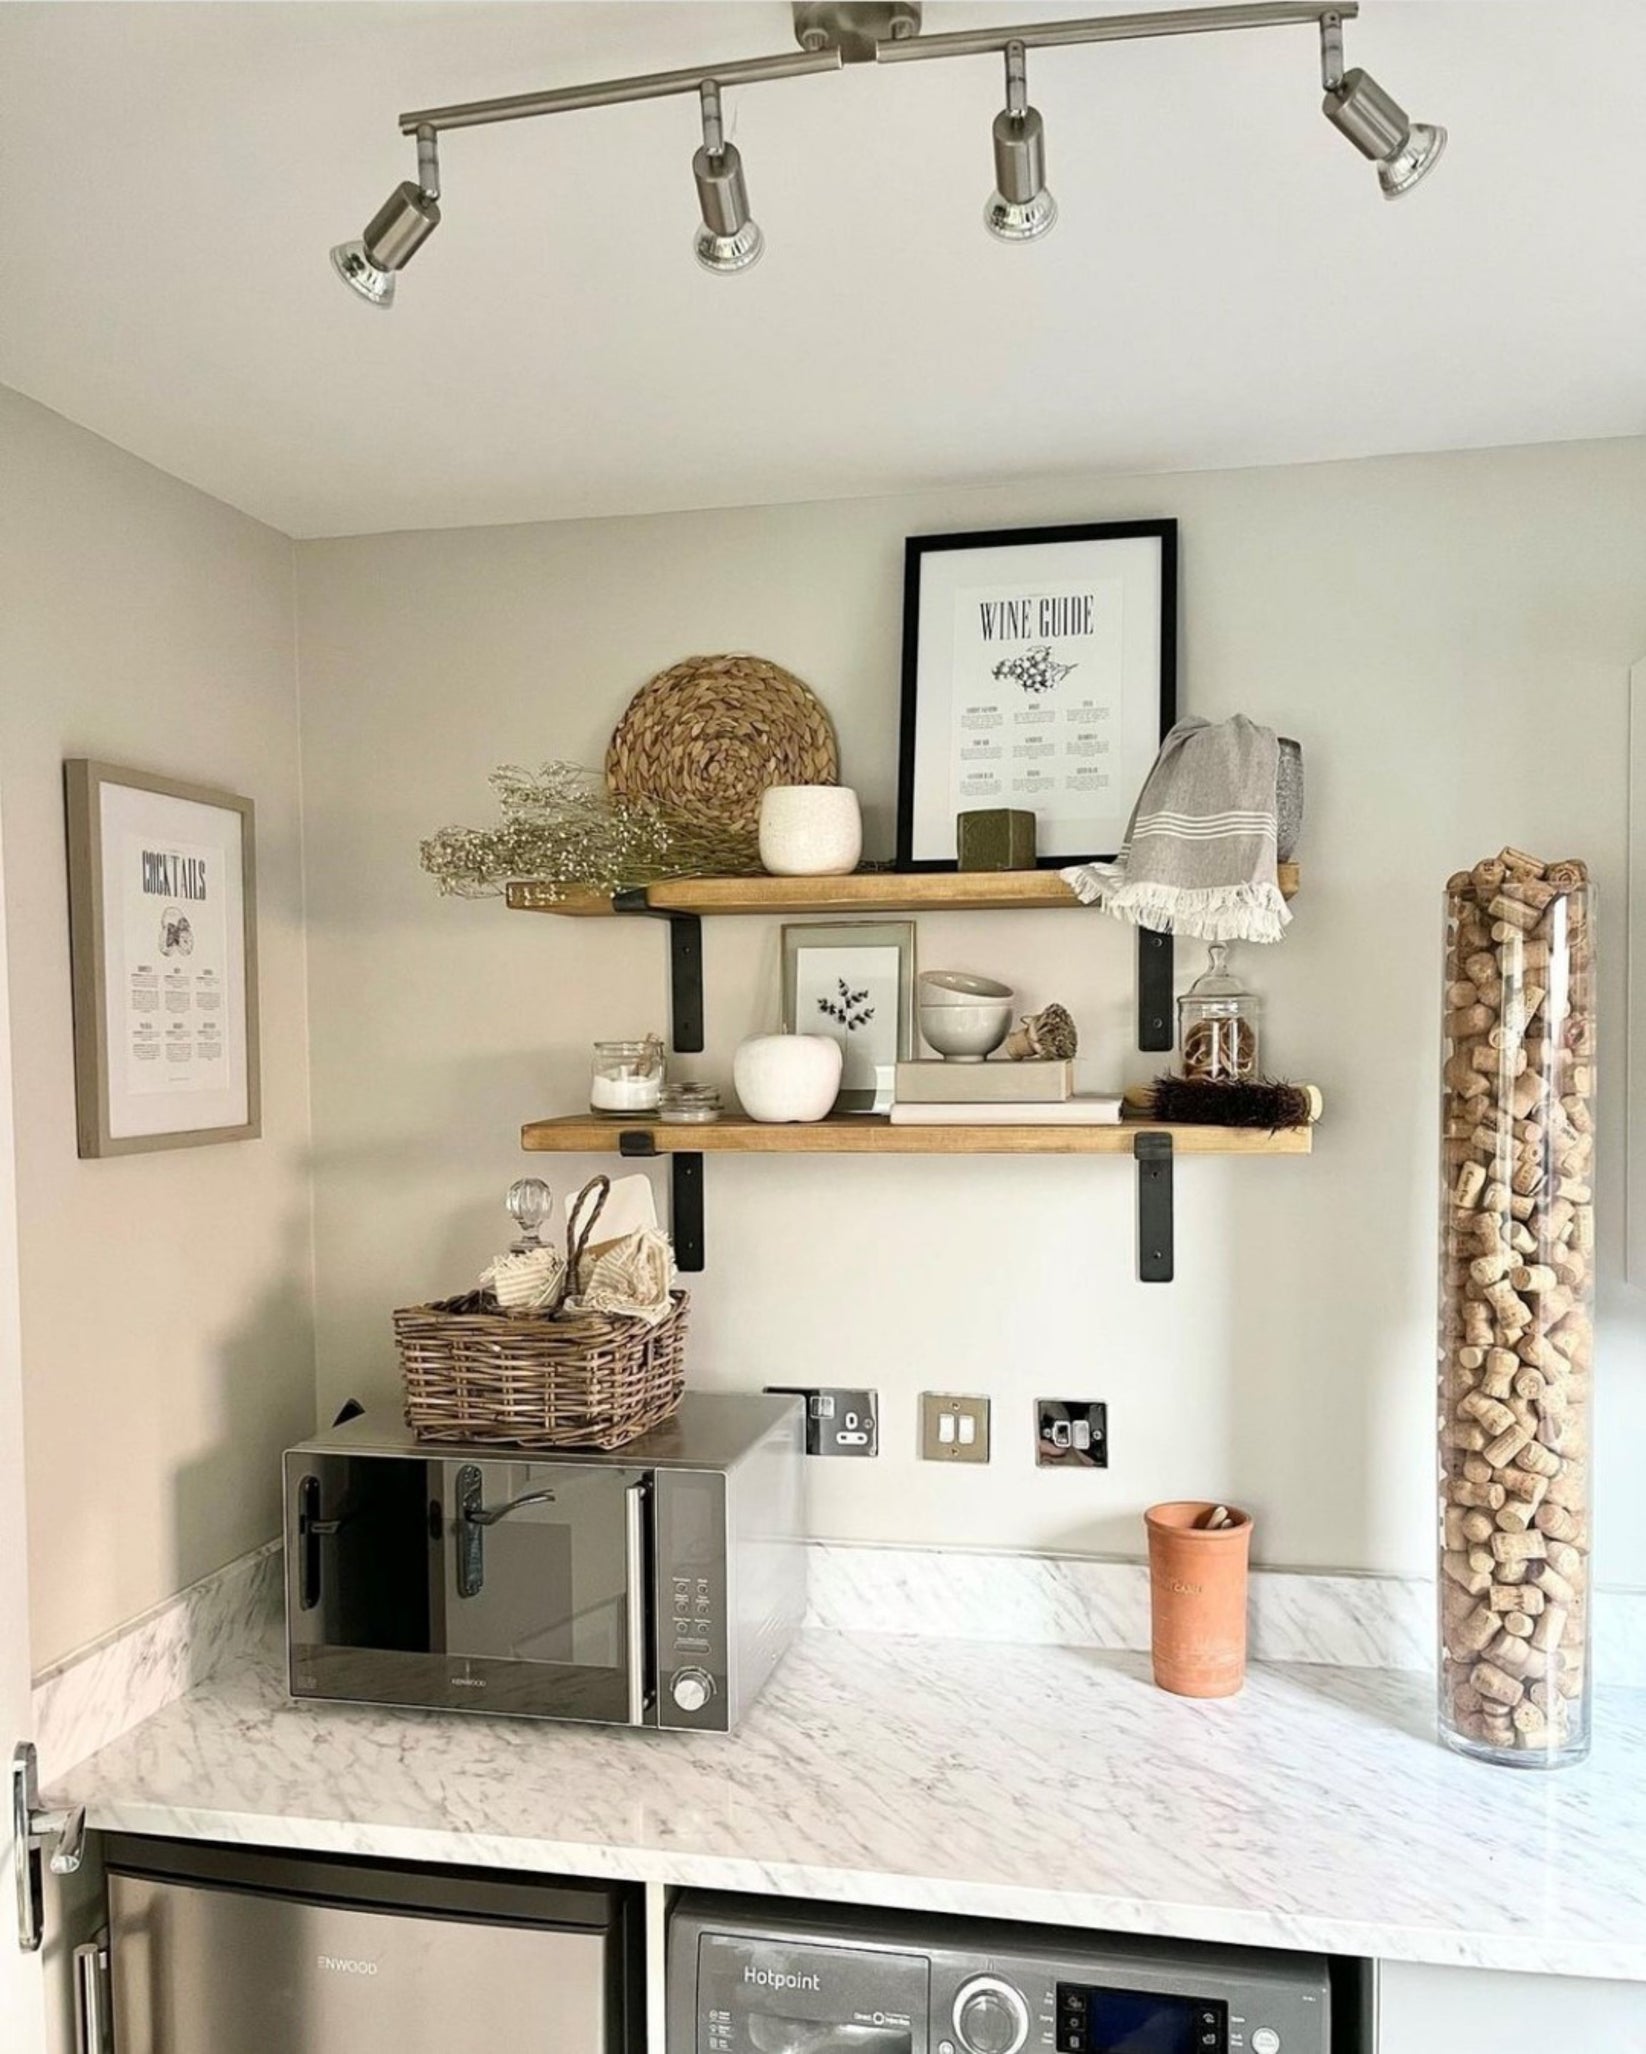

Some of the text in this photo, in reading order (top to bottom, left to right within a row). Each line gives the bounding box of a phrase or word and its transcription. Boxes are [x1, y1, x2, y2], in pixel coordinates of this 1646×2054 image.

[979, 595, 1094, 641] WINE GUIDE
[141, 849, 207, 901] COCKTAILS
[744, 1965, 821, 1992] Hotpoint
